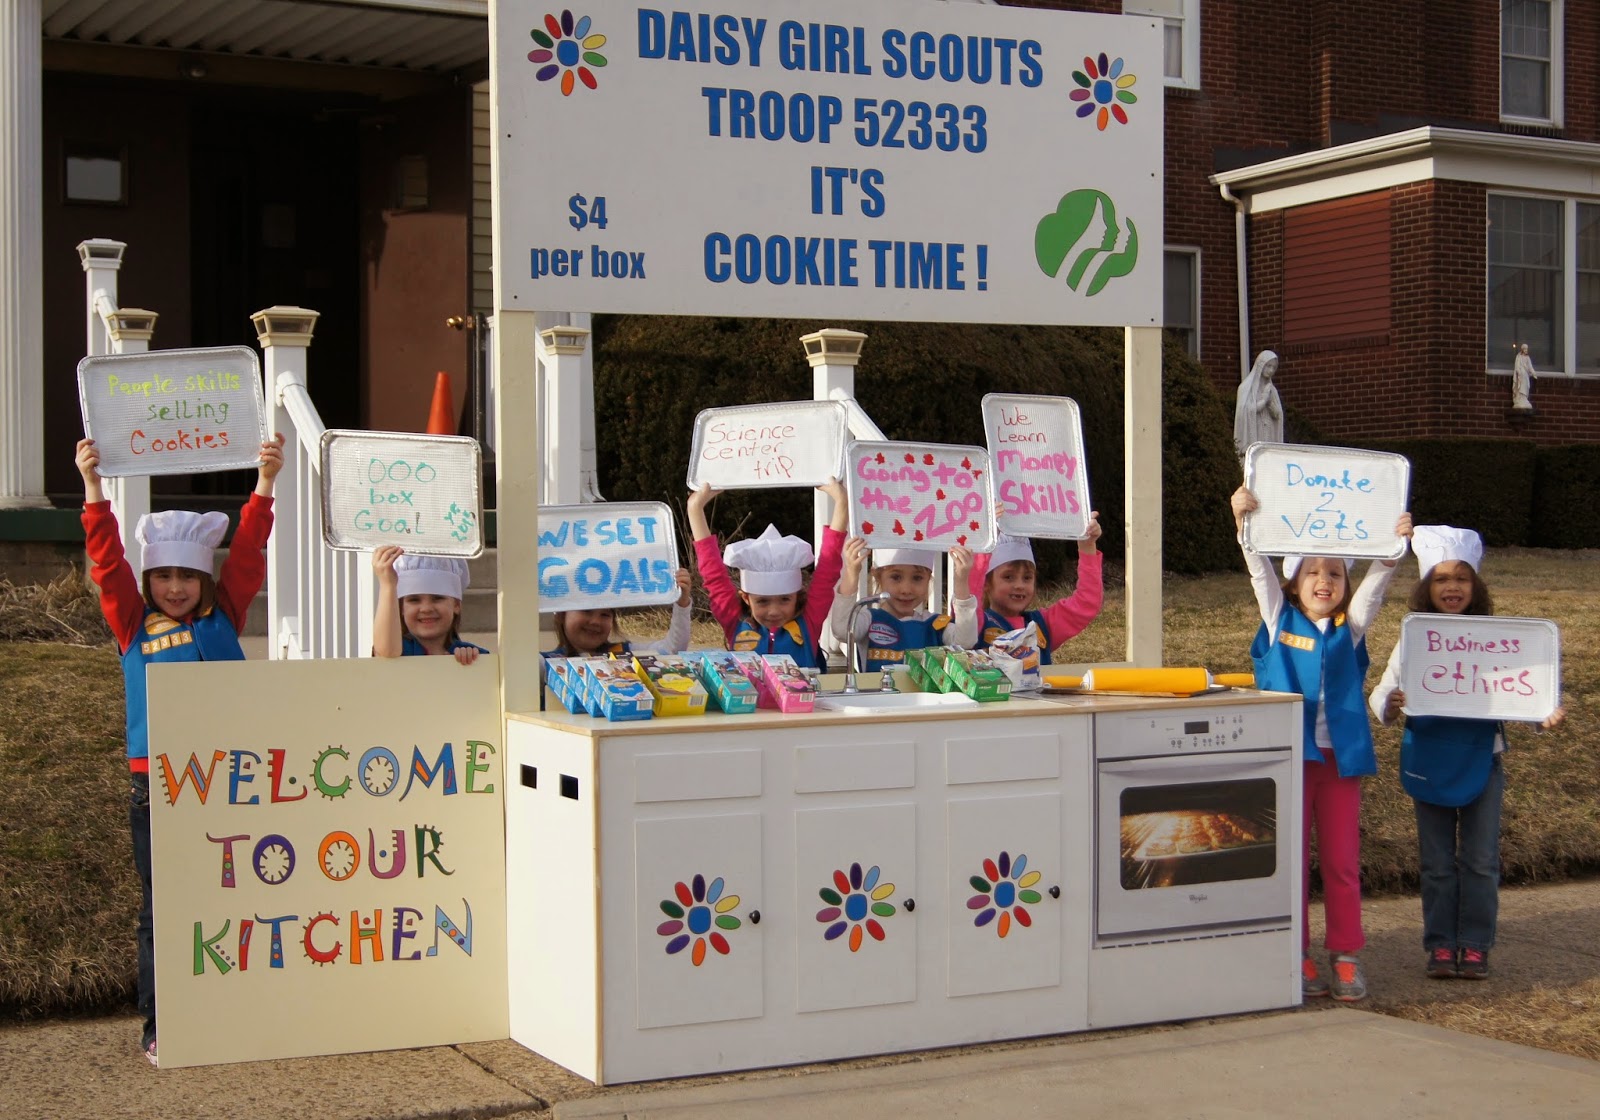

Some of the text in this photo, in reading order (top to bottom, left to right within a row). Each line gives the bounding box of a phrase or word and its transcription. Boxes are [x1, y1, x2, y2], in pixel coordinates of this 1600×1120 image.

[637, 8, 1043, 88] DAISY GIRL SCOUTS
[702, 86, 989, 154] TROOP 52333
[810, 165, 886, 219] IT'S
[568, 192, 608, 230] $4
[530, 243, 646, 280] per box
[703, 231, 859, 288] COOKIE
[868, 238, 966, 291] TIME
[108, 373, 178, 397] People
[1001, 407, 1032, 427] We
[131, 427, 229, 455] Cookies
[707, 423, 796, 444] Science
[997, 425, 1047, 444] Learn
[702, 441, 784, 461] center
[997, 449, 1077, 481] Money
[857, 455, 974, 492] Going to
[1286, 463, 1376, 493] Donate
[369, 487, 413, 507] box
[859, 487, 912, 514] the
[1315, 492, 1342, 513] 2
[1281, 512, 1369, 541] Vets
[143, 632, 189, 653] 52333
[1426, 630, 1520, 653] Business
[156, 740, 496, 807] WELCOME
[206, 824, 455, 888] TO OUR
[193, 898, 473, 976] KITCHEN
